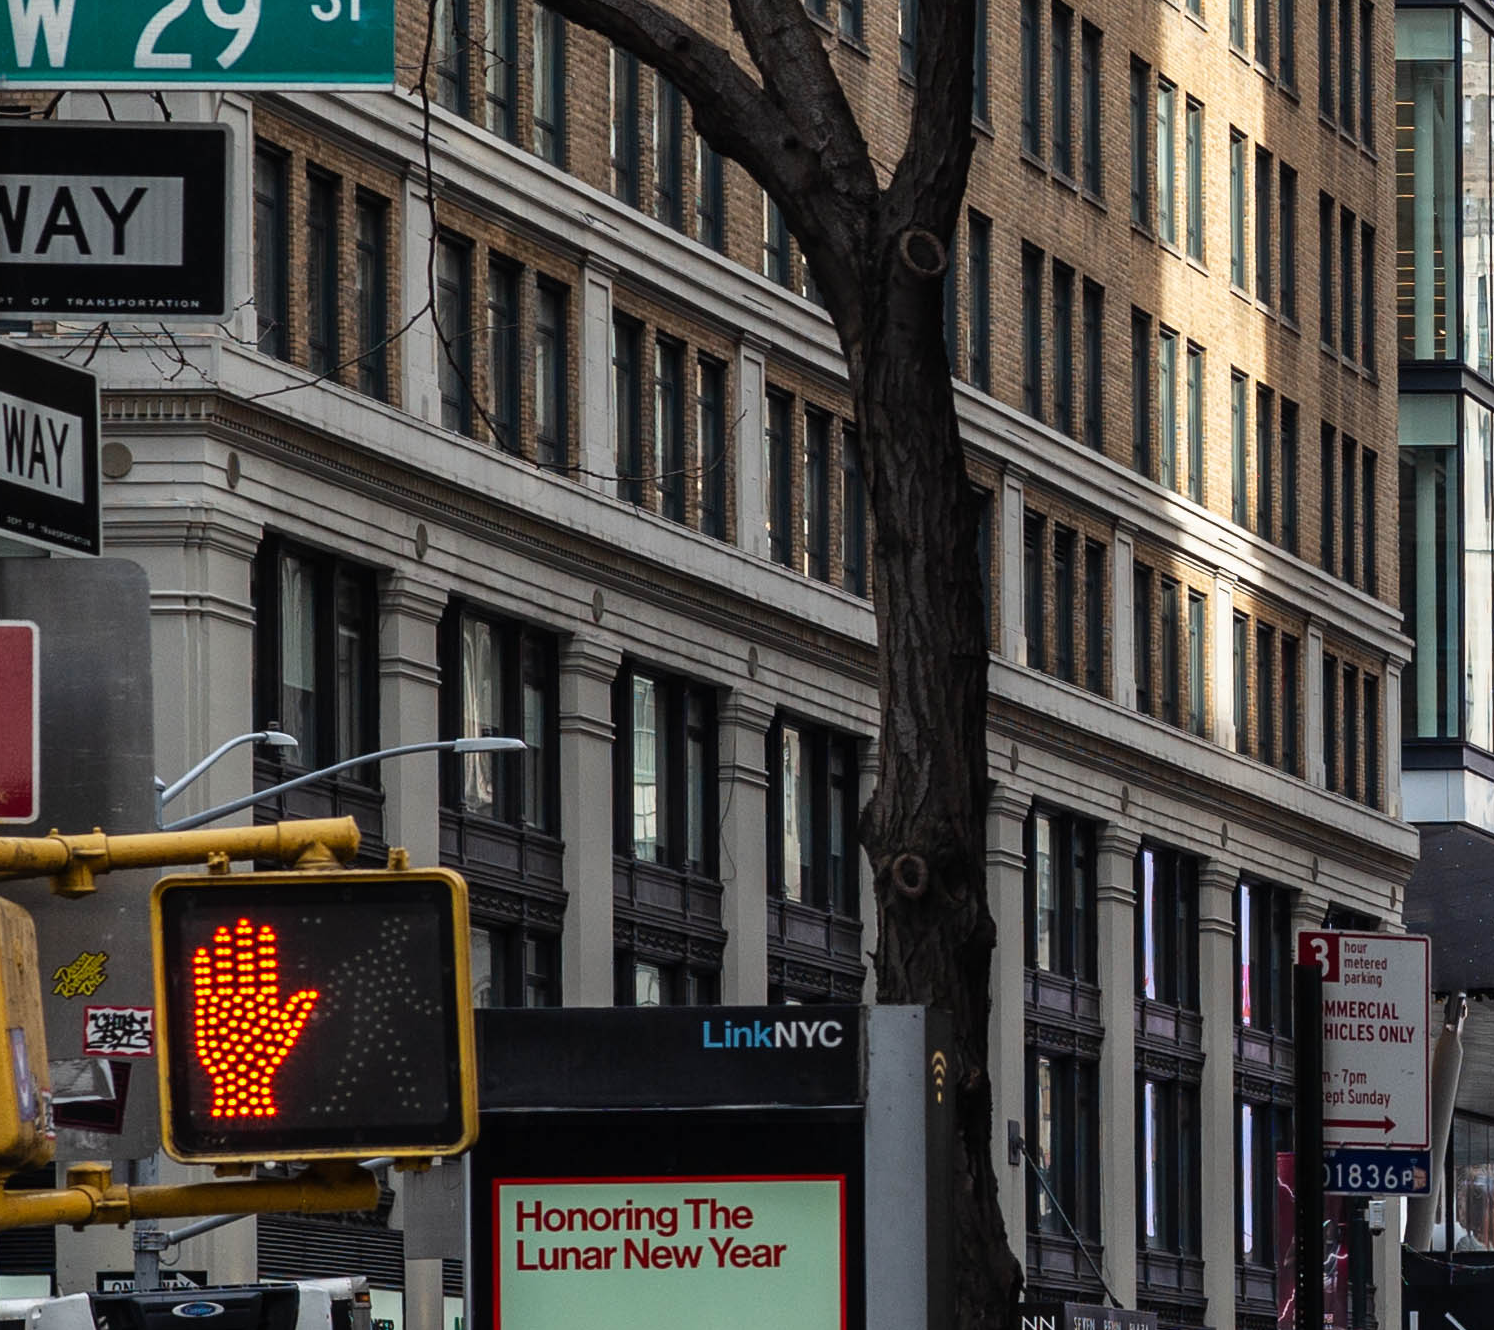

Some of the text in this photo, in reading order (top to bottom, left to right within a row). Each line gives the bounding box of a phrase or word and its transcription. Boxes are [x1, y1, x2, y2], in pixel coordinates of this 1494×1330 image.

[31, 298, 49, 306] OF
[67, 298, 200, 308] TRANSPORTATION
[4, 410, 70, 491] WAY
[1310, 937, 1367, 978] 3 hour
[1344, 957, 1387, 971] metered
[1344, 971, 1383, 988] parking
[703, 1021, 843, 1048] LinkNYC
[1323, 1024, 1415, 1044] HICLES ONLY
[1342, 1069, 1367, 1087] 7pm
[1322, 1089, 1390, 1108] cept Sunday
[515, 1199, 754, 1237] Honoring The
[516, 1237, 787, 1270] Lunar New Year
